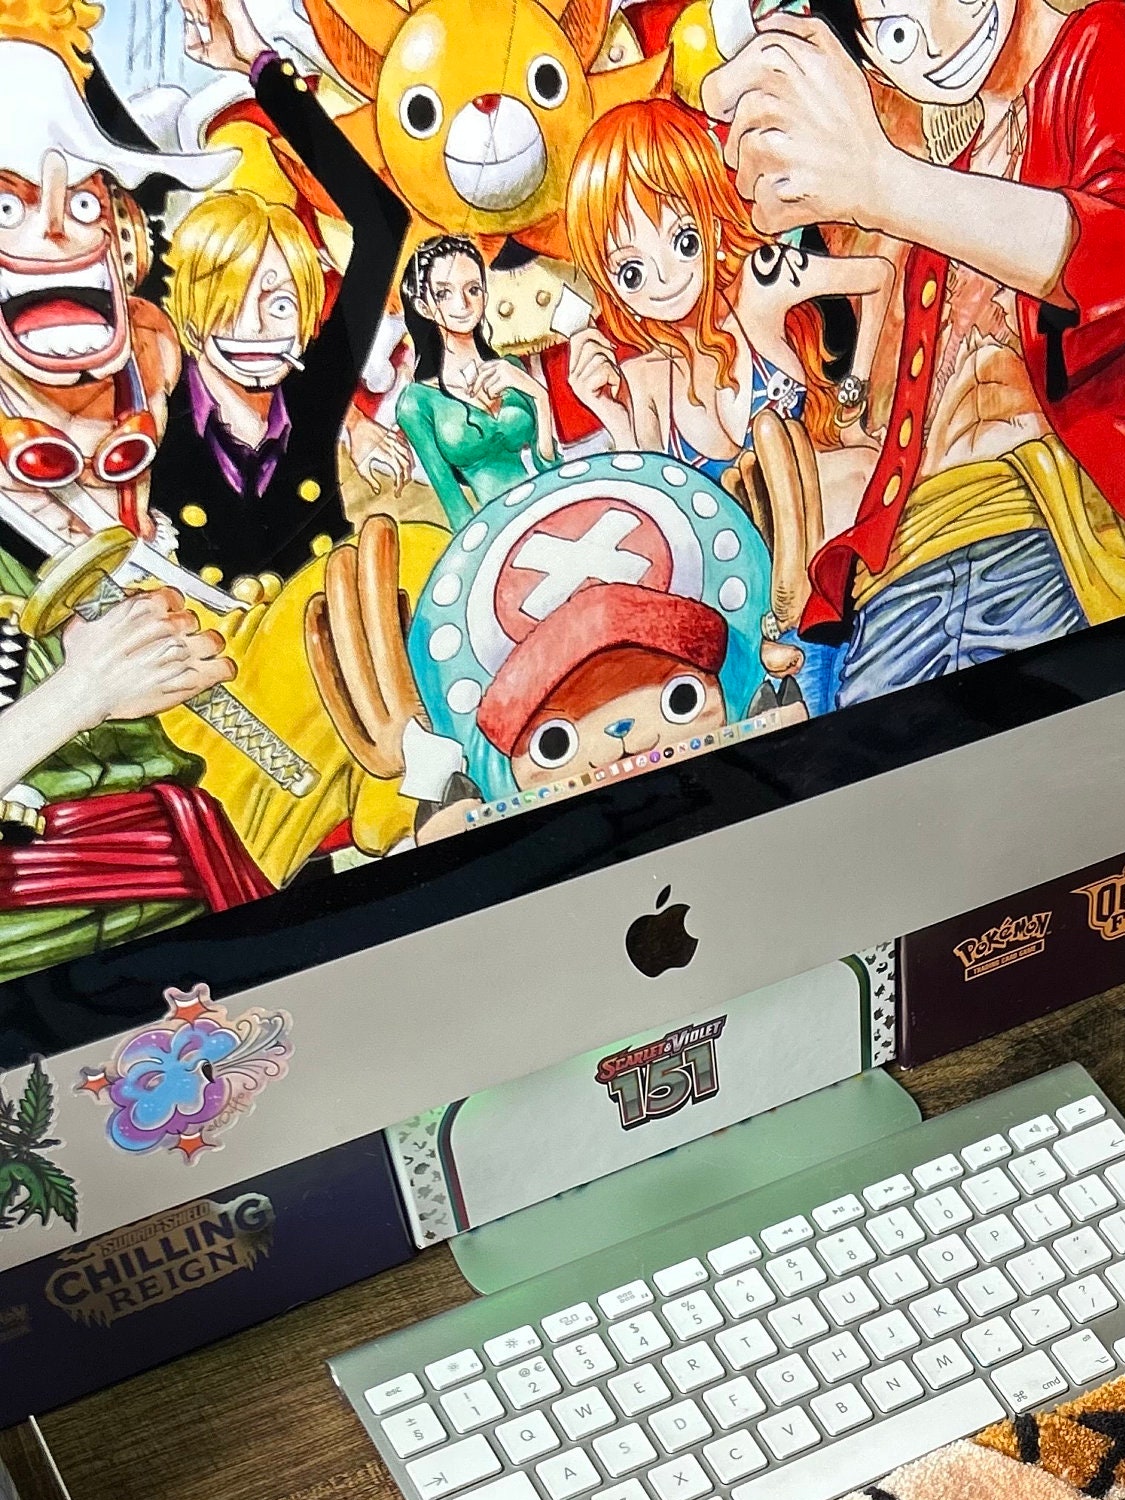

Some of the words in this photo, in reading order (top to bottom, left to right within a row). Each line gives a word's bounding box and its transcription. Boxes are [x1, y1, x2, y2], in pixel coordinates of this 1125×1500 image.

[597, 1044, 665, 1081] SCARLET
[666, 1019, 723, 1053] VIOLET
[609, 1038, 721, 1131] 151
[895, 1229, 905, 1240] 9
[989, 1230, 1000, 1242] P
[51, 1197, 273, 1306] CHILLING
[848, 1250, 858, 1260] 8
[941, 1250, 954, 1262] O
[108, 1244, 239, 1314] REIGN
[745, 1292, 755, 1302] 6
[842, 1292, 856, 1304] U
[933, 1305, 948, 1318] K
[693, 1314, 704, 1325] 5
[792, 1313, 804, 1326] Y
[638, 1336, 649, 1347] 4
[740, 1336, 752, 1349] T
[831, 1348, 848, 1362] H
[584, 1358, 595, 1370] 3
[687, 1358, 701, 1371] R
[936, 1355, 953, 1369] M
[781, 1371, 795, 1383] G
[1042, 1376, 1062, 1391] cmd
[528, 1382, 541, 1394] 2
[634, 1382, 646, 1394] E
[885, 1377, 901, 1391] N
[728, 1394, 741, 1407] F
[575, 1403, 592, 1418] W
[835, 1402, 848, 1414] B
[674, 1417, 687, 1430] D
[781, 1423, 794, 1436] V
[520, 1429, 536, 1441] Q
[619, 1442, 631, 1454] S
[729, 1448, 743, 1460] C
[564, 1467, 577, 1480] A
[672, 1471, 689, 1486] X
